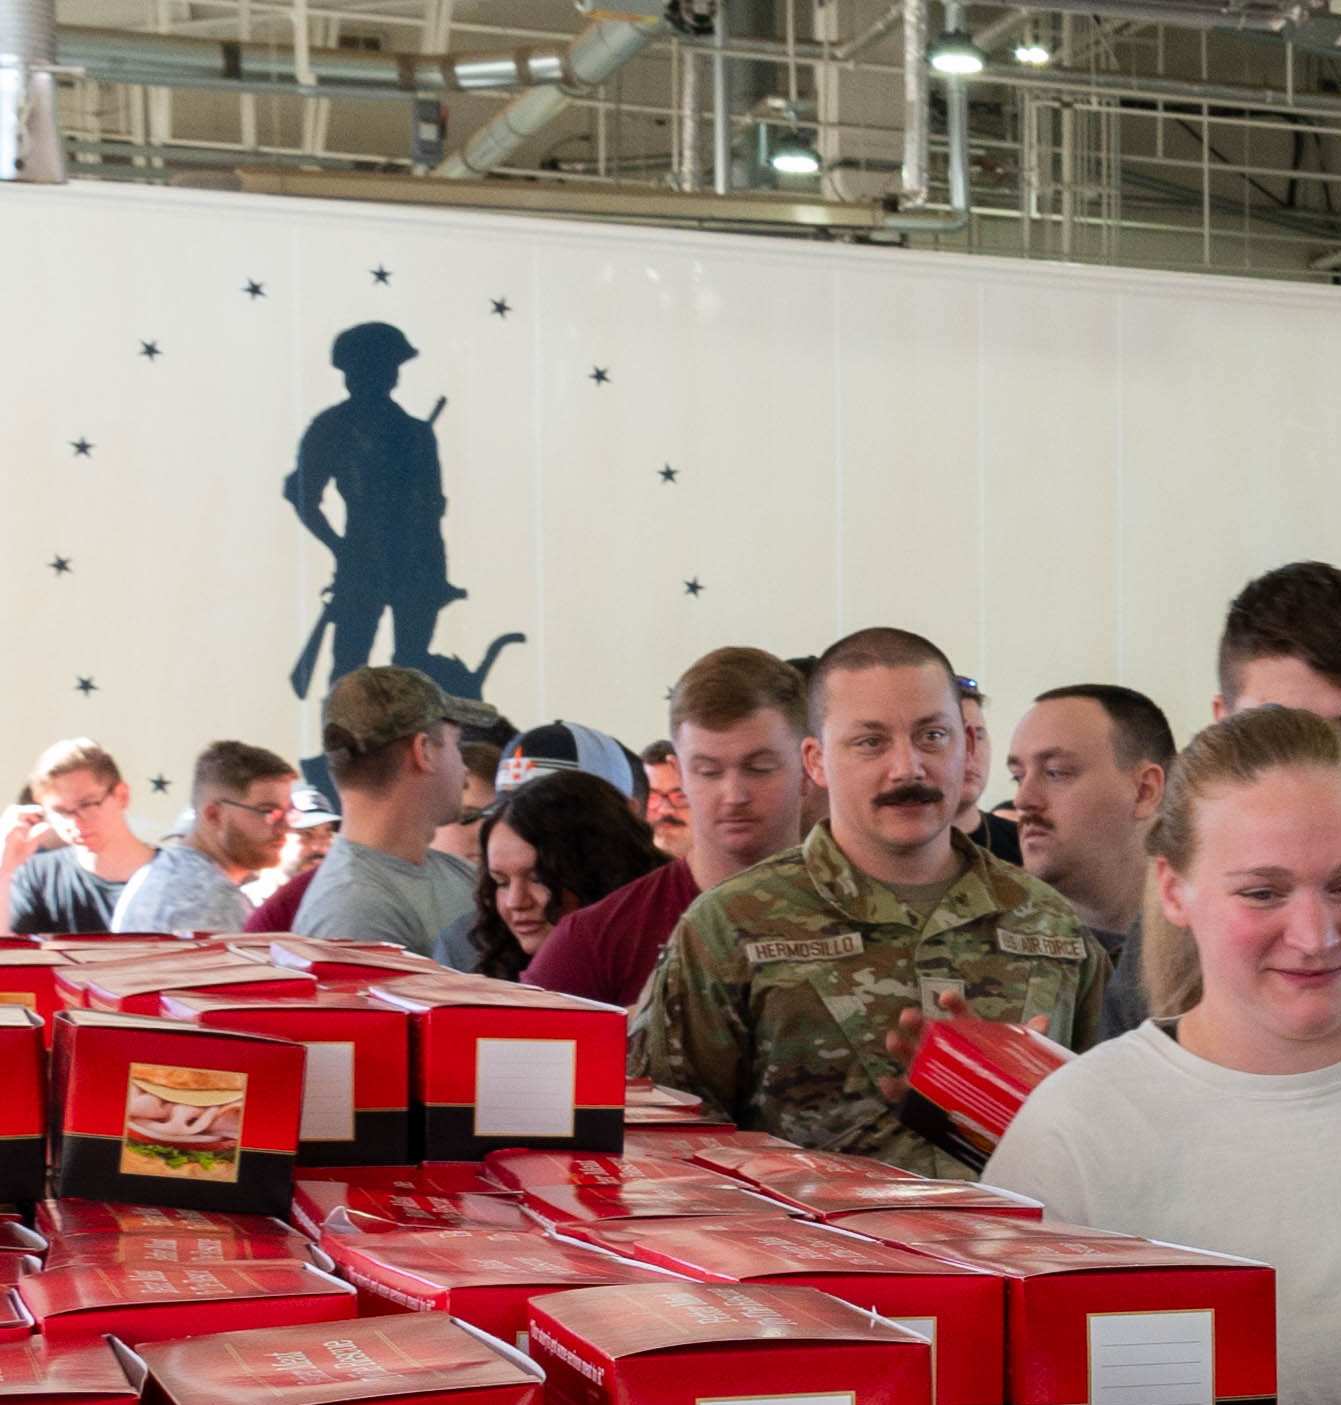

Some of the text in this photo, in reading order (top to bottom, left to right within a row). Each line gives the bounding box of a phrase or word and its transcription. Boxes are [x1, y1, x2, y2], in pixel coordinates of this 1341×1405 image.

[756, 937, 855, 960] HERMOSILLO
[1020, 937, 1046, 953] AIR
[1044, 939, 1081, 957] FORCE
